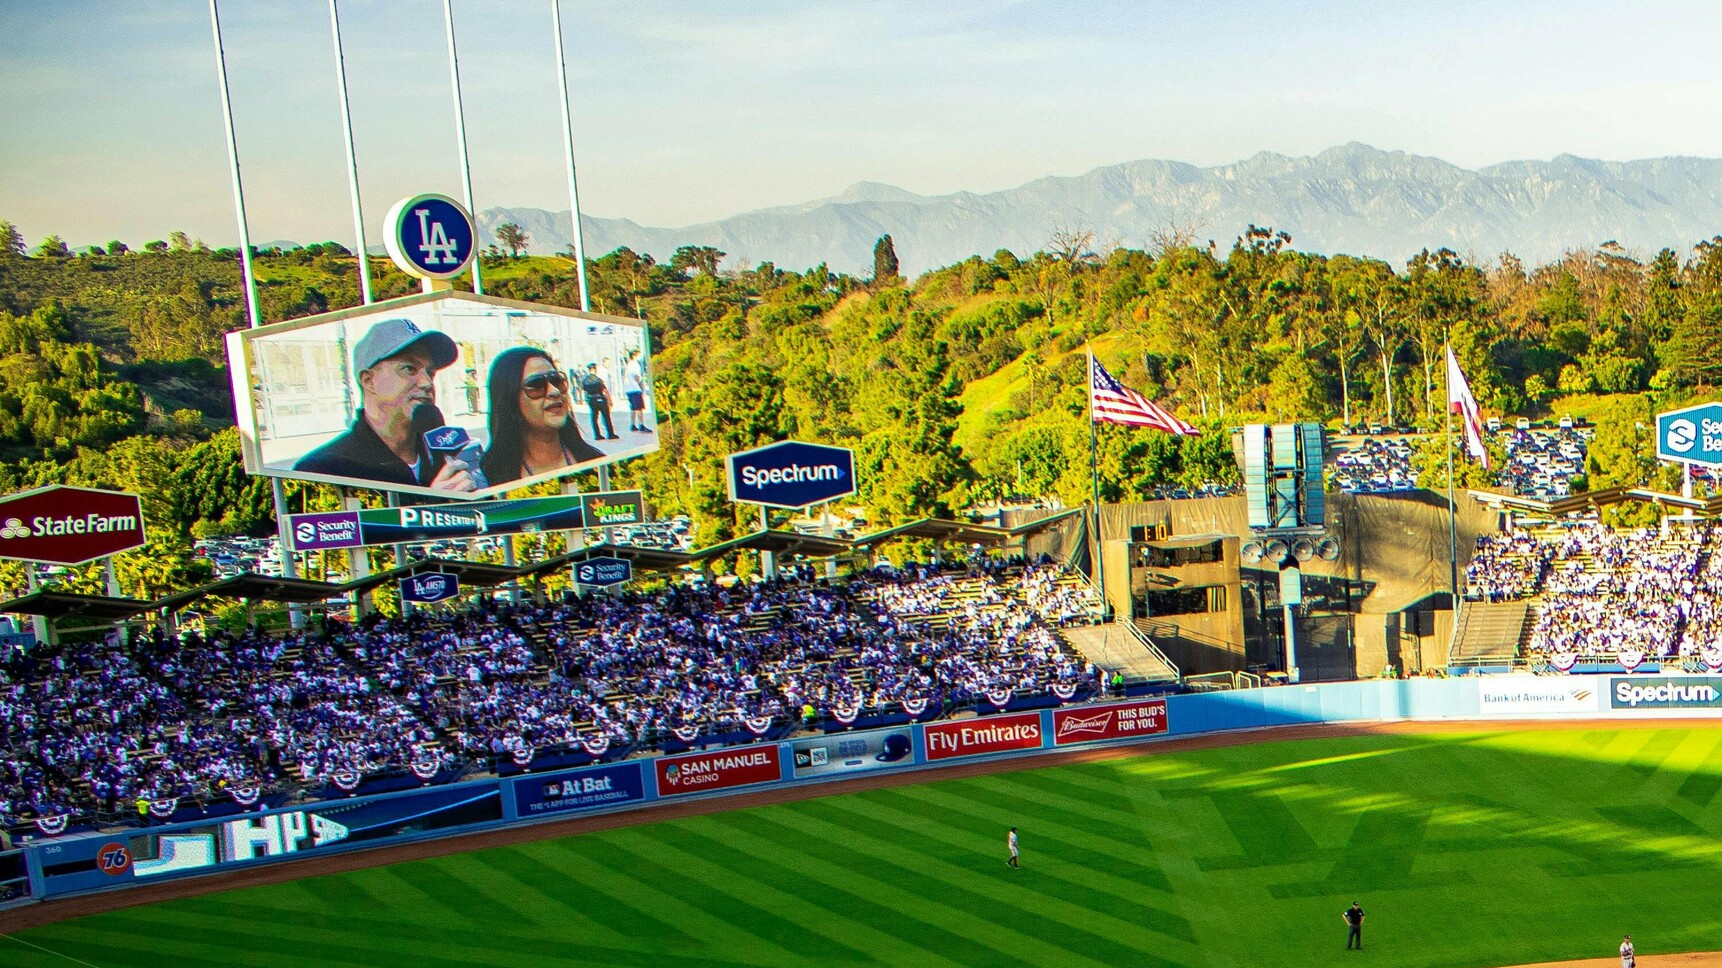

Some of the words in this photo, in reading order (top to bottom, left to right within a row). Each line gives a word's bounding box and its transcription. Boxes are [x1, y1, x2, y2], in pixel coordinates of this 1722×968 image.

[415, 209, 457, 264] LA
[742, 463, 839, 489] Spectrum
[600, 512, 636, 522] KINGS
[318, 519, 357, 534] Security
[319, 530, 354, 542] Benefit
[596, 562, 626, 573] Security
[597, 570, 623, 580] Benefit
[1484, 693, 1509, 703] Bank
[1523, 693, 1565, 702] America
[1616, 682, 1714, 706] Spectrum
[1117, 708, 1137, 720] THIS
[1138, 705, 1165, 718] BUD'S
[1061, 716, 1111, 733] Budweiser
[1118, 719, 1135, 731] FOR
[1137, 717, 1158, 729] YOU.
[929, 731, 959, 752] Fly
[962, 722, 1039, 746] Emirates
[681, 759, 711, 775] SAN
[713, 753, 771, 771] MANUEL
[562, 780, 582, 796] At
[582, 776, 612, 793] Bat
[683, 773, 719, 786] CASINO
[565, 798, 579, 806] FOR
[102, 850, 127, 868] 76
